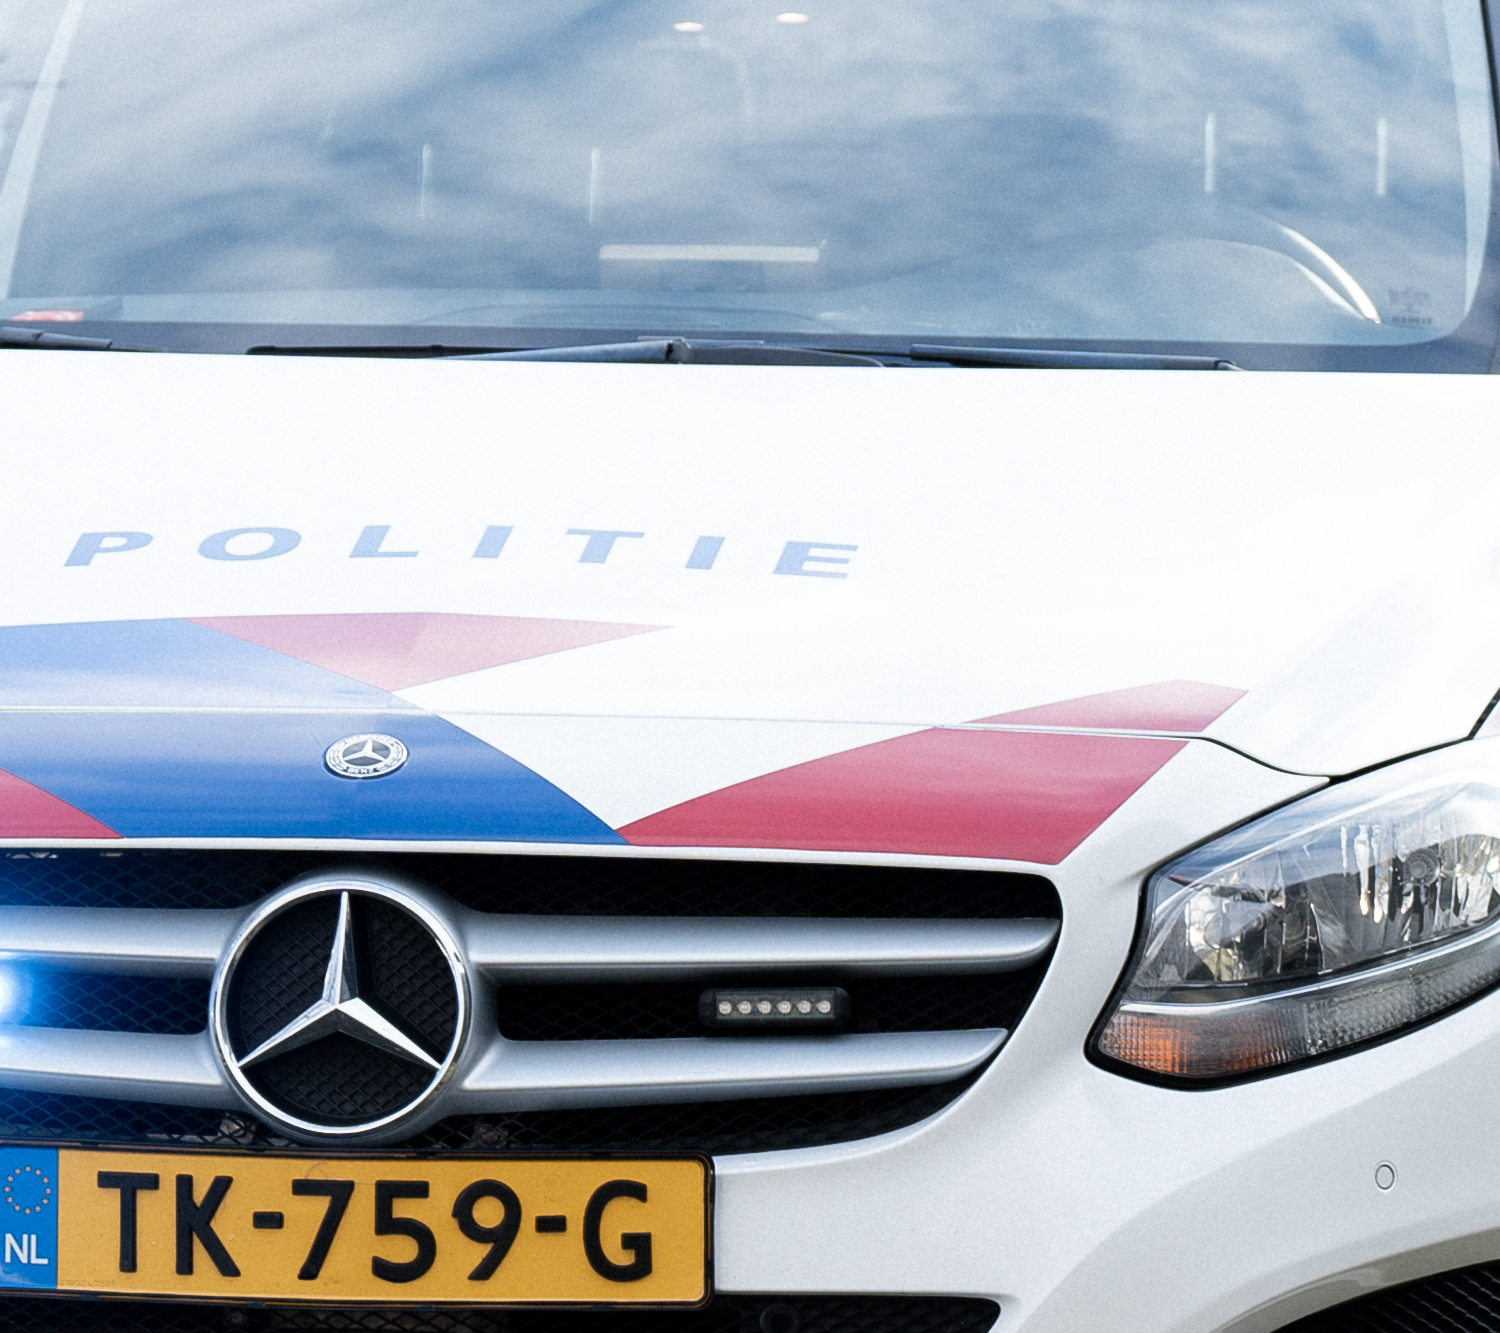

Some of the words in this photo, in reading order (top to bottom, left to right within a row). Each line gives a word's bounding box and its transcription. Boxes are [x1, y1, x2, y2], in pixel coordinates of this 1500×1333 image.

[62, 524, 859, 579] POLITIE
[3, 1232, 49, 1266] NL
[97, 1169, 653, 1284] TK-759-G
